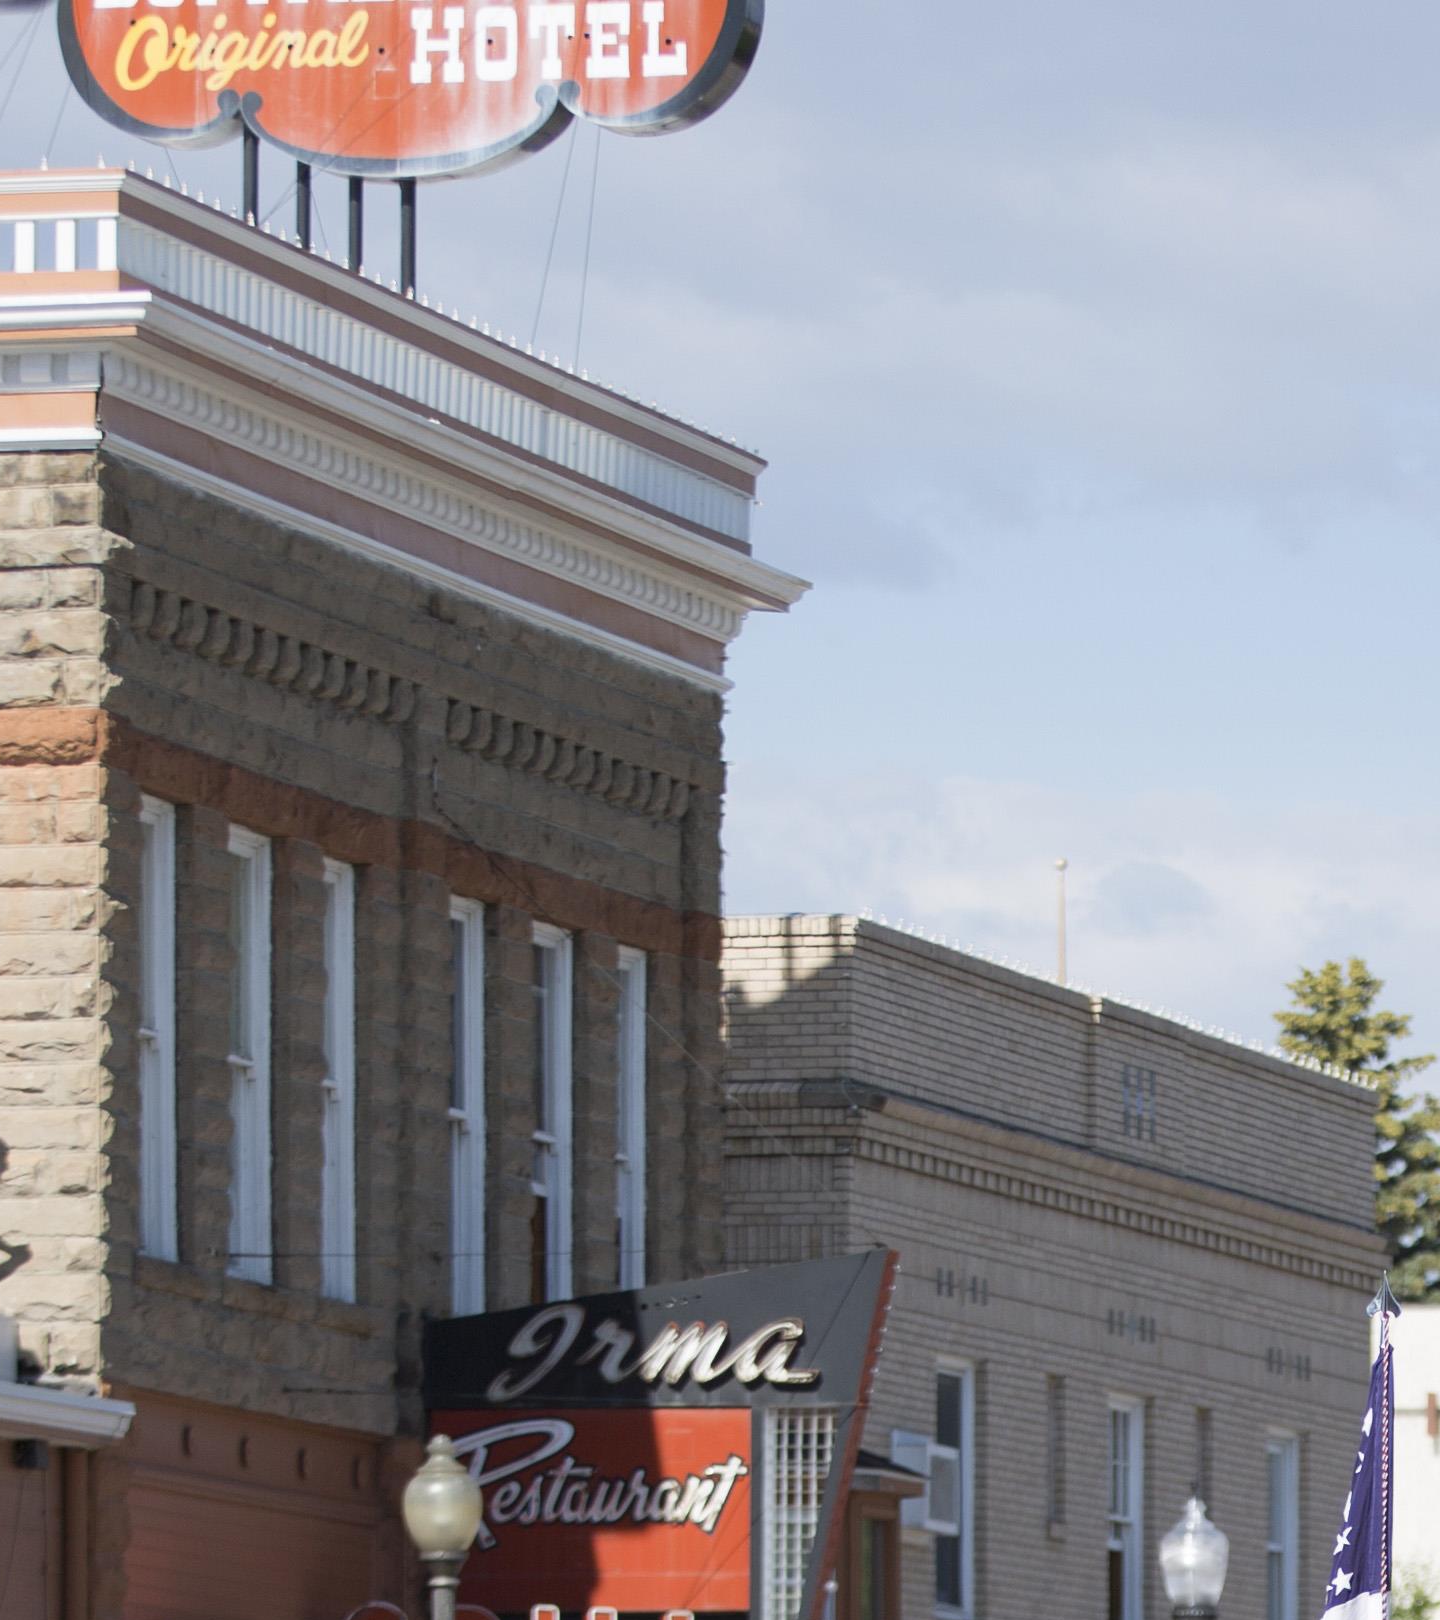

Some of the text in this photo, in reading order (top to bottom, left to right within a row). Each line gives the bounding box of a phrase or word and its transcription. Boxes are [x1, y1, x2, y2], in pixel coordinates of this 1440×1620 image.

[115, 11, 368, 91] Original
[409, 1, 688, 85] HOTEL
[487, 1303, 821, 1401] Irma
[449, 1419, 748, 1552] Restaurant
